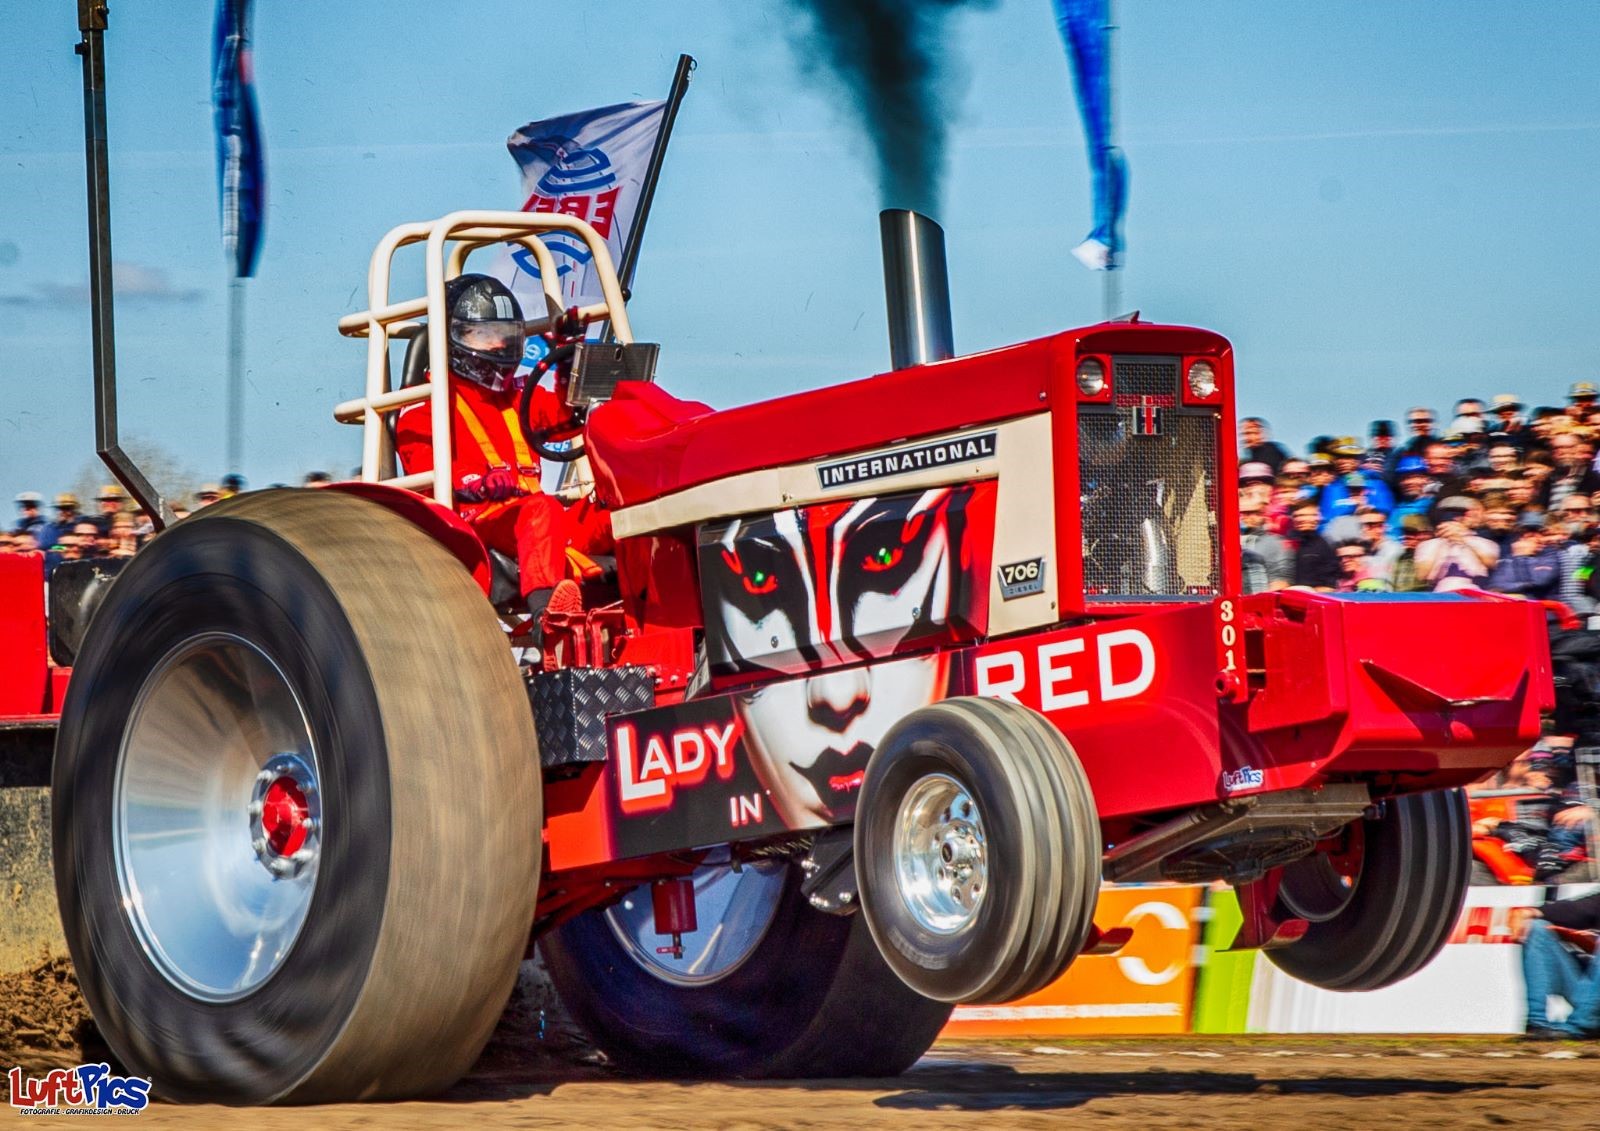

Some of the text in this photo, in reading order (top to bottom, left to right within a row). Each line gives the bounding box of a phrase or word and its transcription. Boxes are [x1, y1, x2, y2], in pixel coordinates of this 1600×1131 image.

[822, 438, 992, 485] INTERNATIONAL
[1005, 562, 1039, 584] 706
[1220, 600, 1237, 671] 301
[975, 628, 1156, 712] RED
[730, 793, 764, 823] IN
